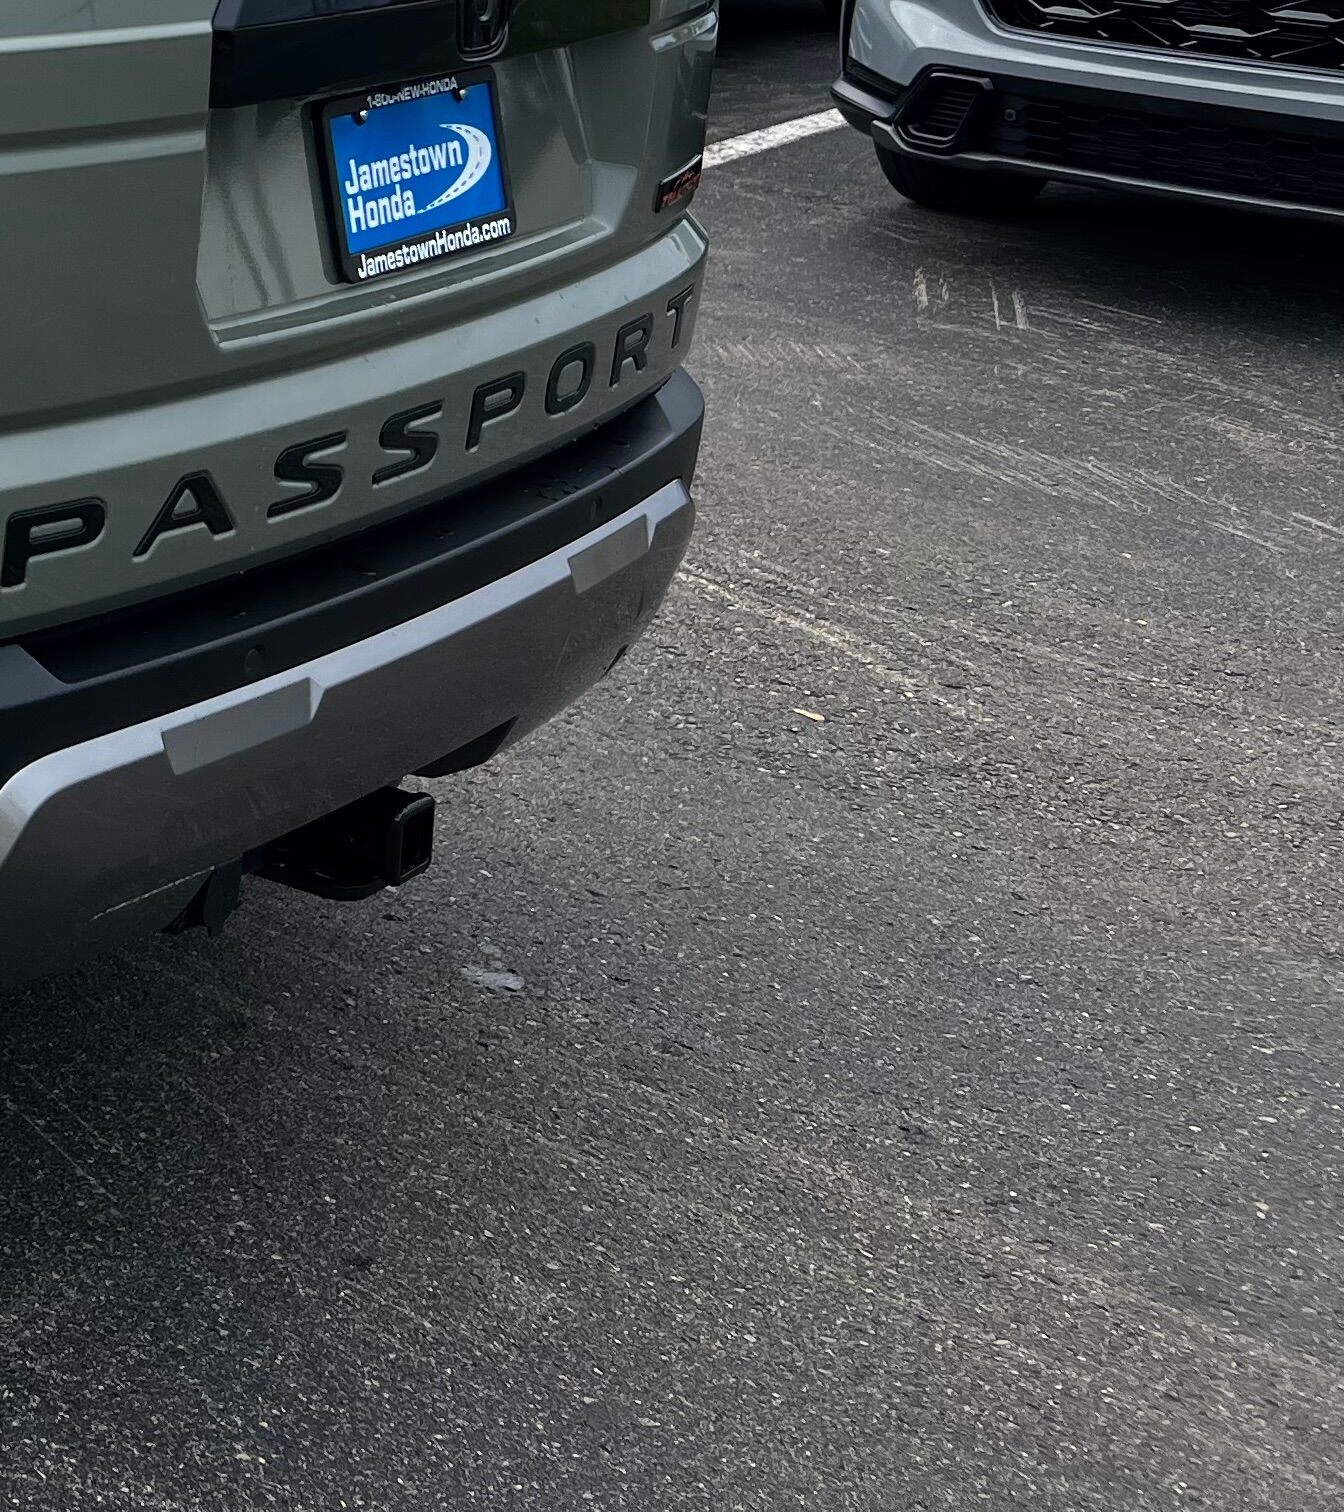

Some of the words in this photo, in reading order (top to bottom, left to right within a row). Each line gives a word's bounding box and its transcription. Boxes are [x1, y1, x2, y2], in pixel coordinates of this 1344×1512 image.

[345, 139, 463, 195] Jamestown
[348, 184, 416, 233] Honda
[357, 217, 511, 279] JamestownHonda.com
[0, 286, 695, 590] PASSPORT
